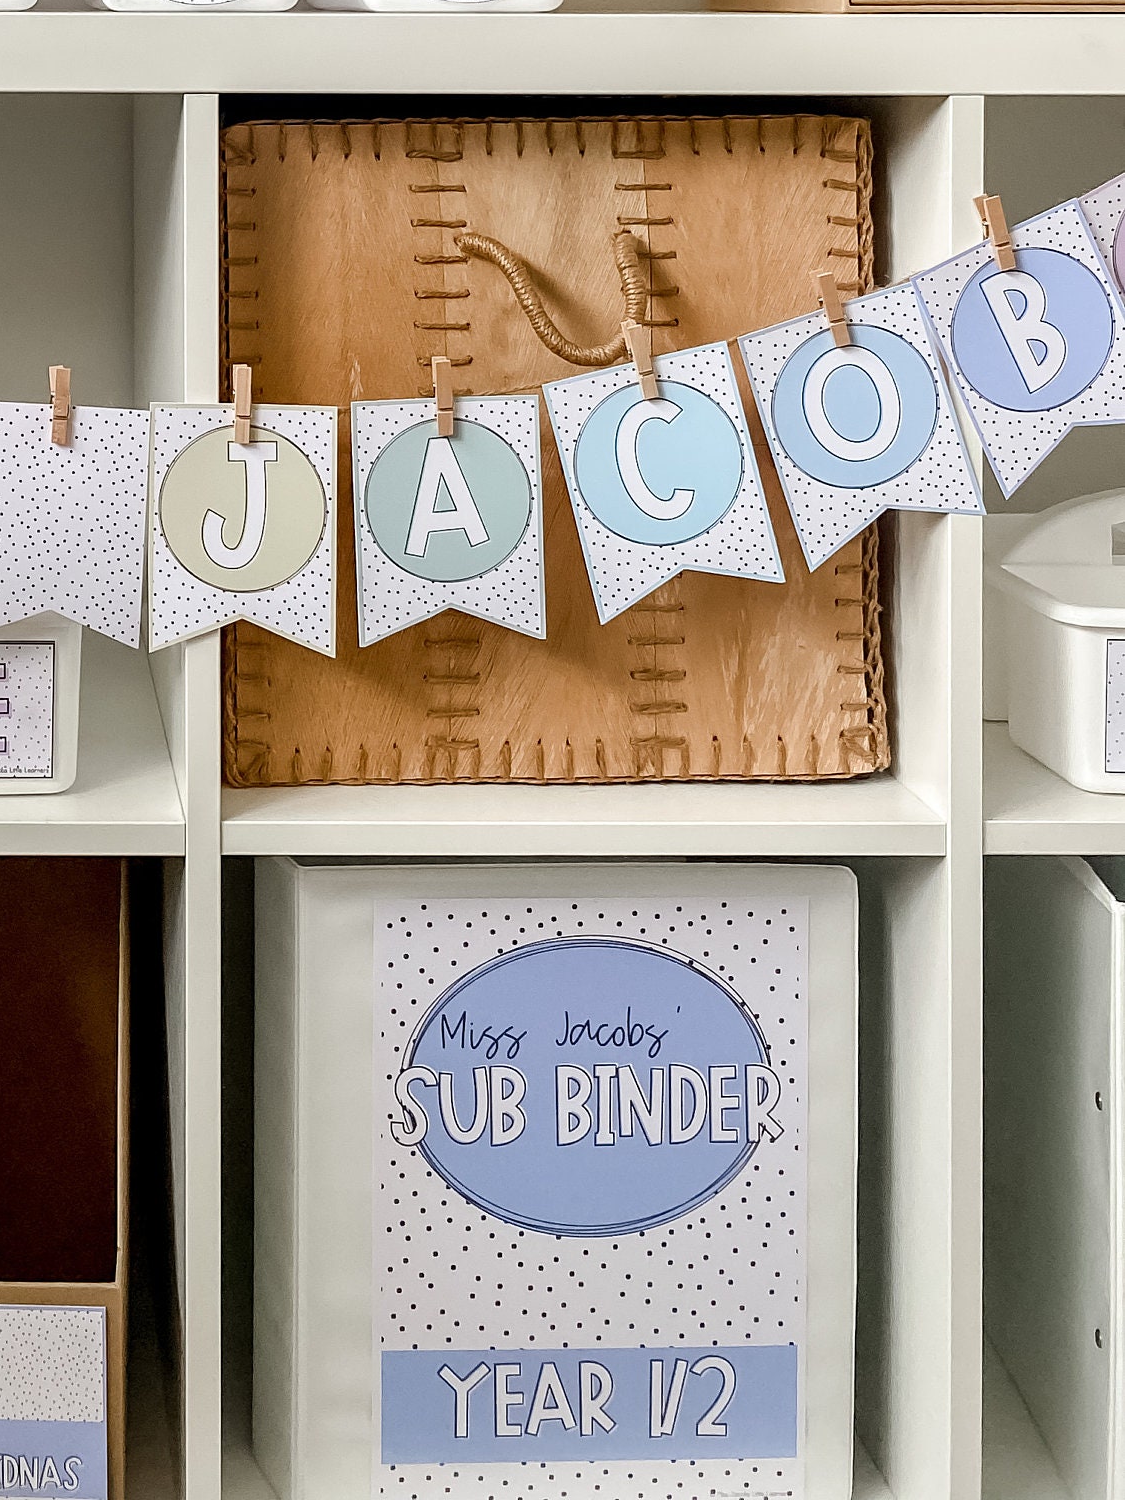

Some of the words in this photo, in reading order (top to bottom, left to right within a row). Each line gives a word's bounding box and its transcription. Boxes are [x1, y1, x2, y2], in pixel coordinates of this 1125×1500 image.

[440, 1011, 527, 1059] Miss
[389, 1064, 527, 1147] SUB
[555, 1062, 784, 1147] BINDER
[437, 1360, 617, 1439] YEAR
